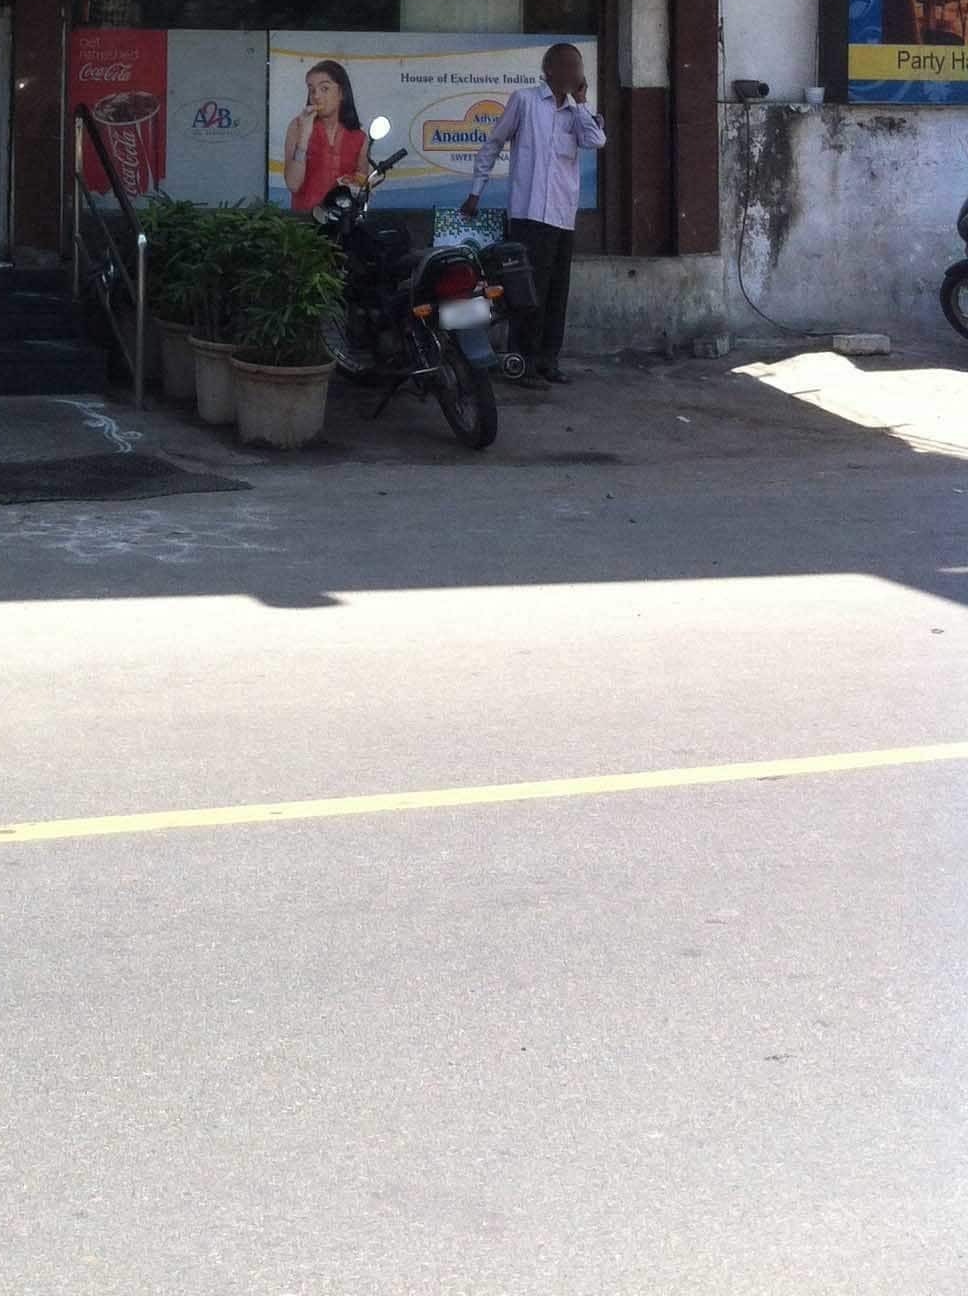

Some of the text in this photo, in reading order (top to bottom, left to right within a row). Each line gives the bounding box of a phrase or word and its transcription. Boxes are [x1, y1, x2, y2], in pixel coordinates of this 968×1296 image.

[898, 50, 945, 75] Party
[401, 73, 434, 84] House
[437, 73, 448, 83] of
[451, 73, 499, 84] Exclusive
[503, 74, 535, 84] Indian
[192, 100, 232, 128] A2B
[433, 128, 486, 143] Ananda
